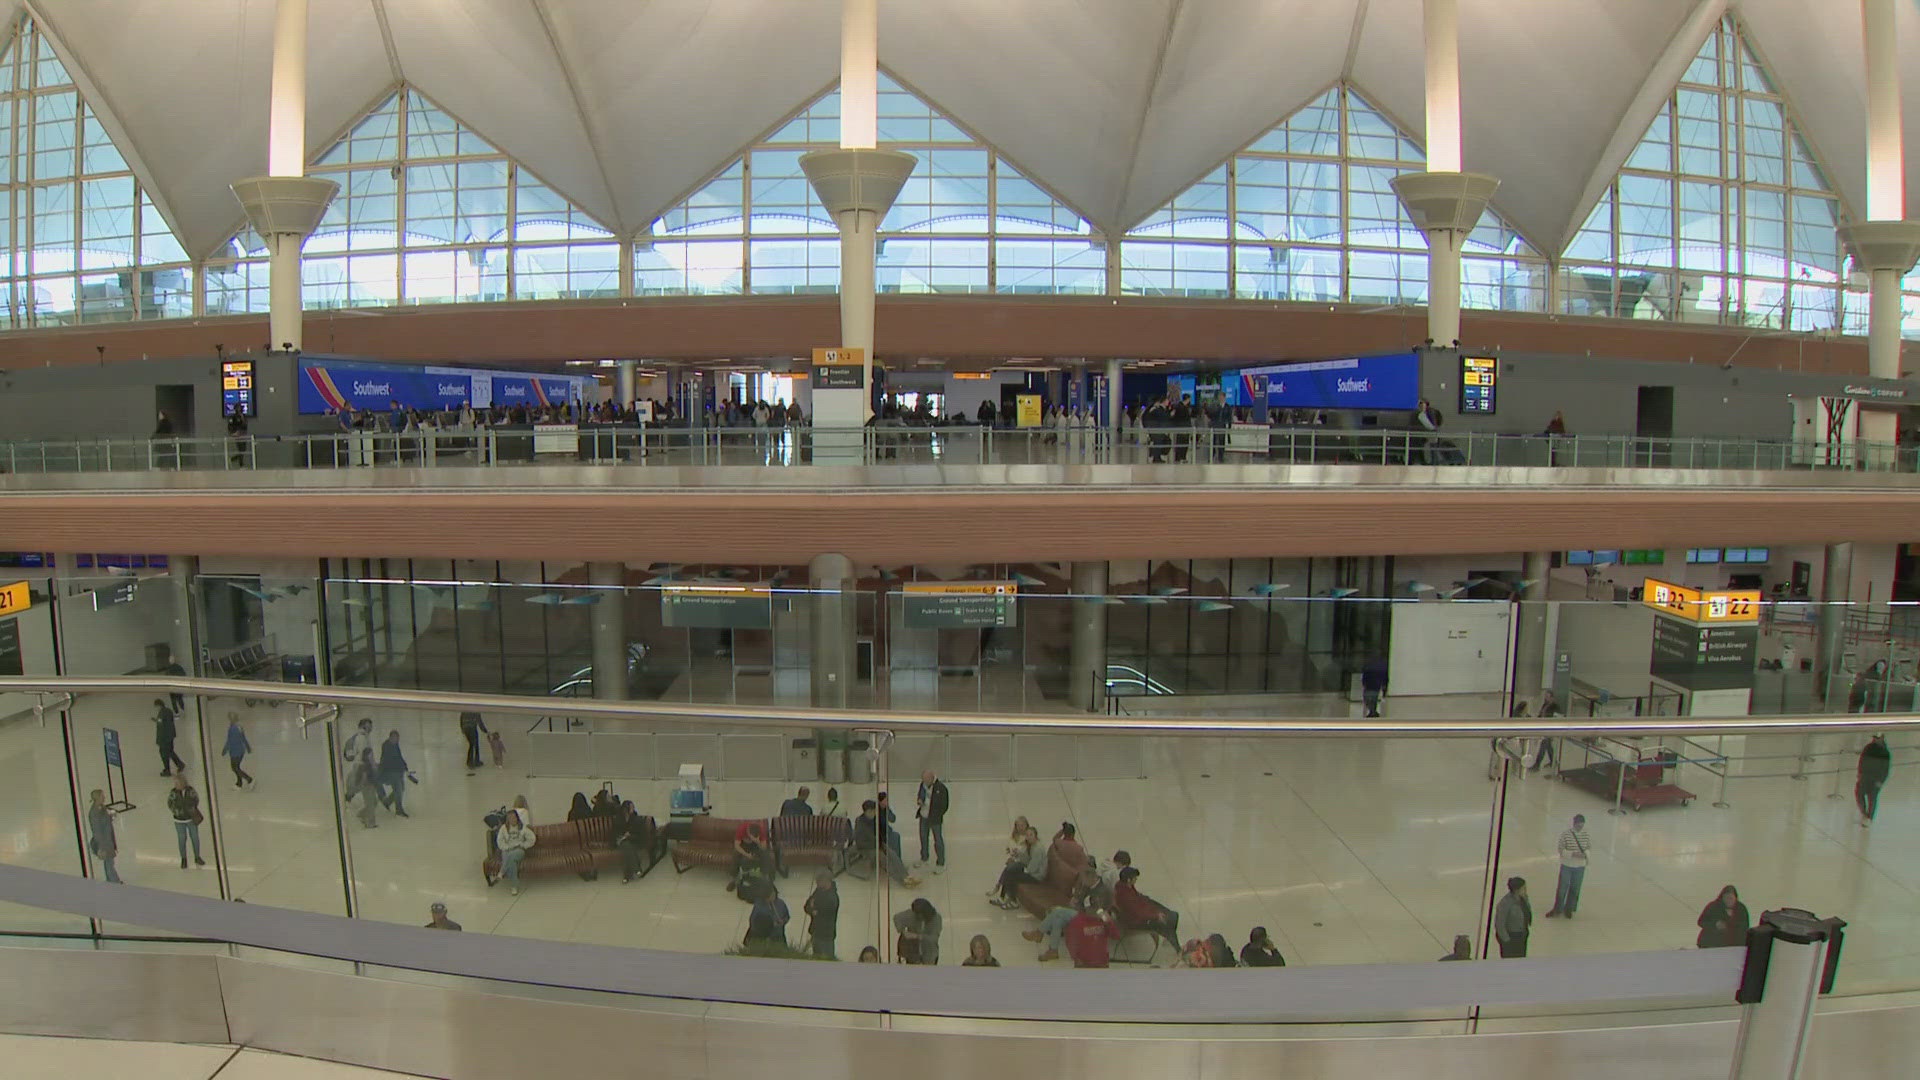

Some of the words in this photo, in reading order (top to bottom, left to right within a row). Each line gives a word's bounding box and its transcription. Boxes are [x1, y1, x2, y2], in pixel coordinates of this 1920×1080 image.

[353, 380, 390, 396] Southwest
[438, 383, 466, 396] Southwest
[1337, 377, 1368, 393] Southwest
[0, 591, 12, 608] 21
[1670, 592, 1684, 610] 22
[1730, 598, 1750, 615] 22
